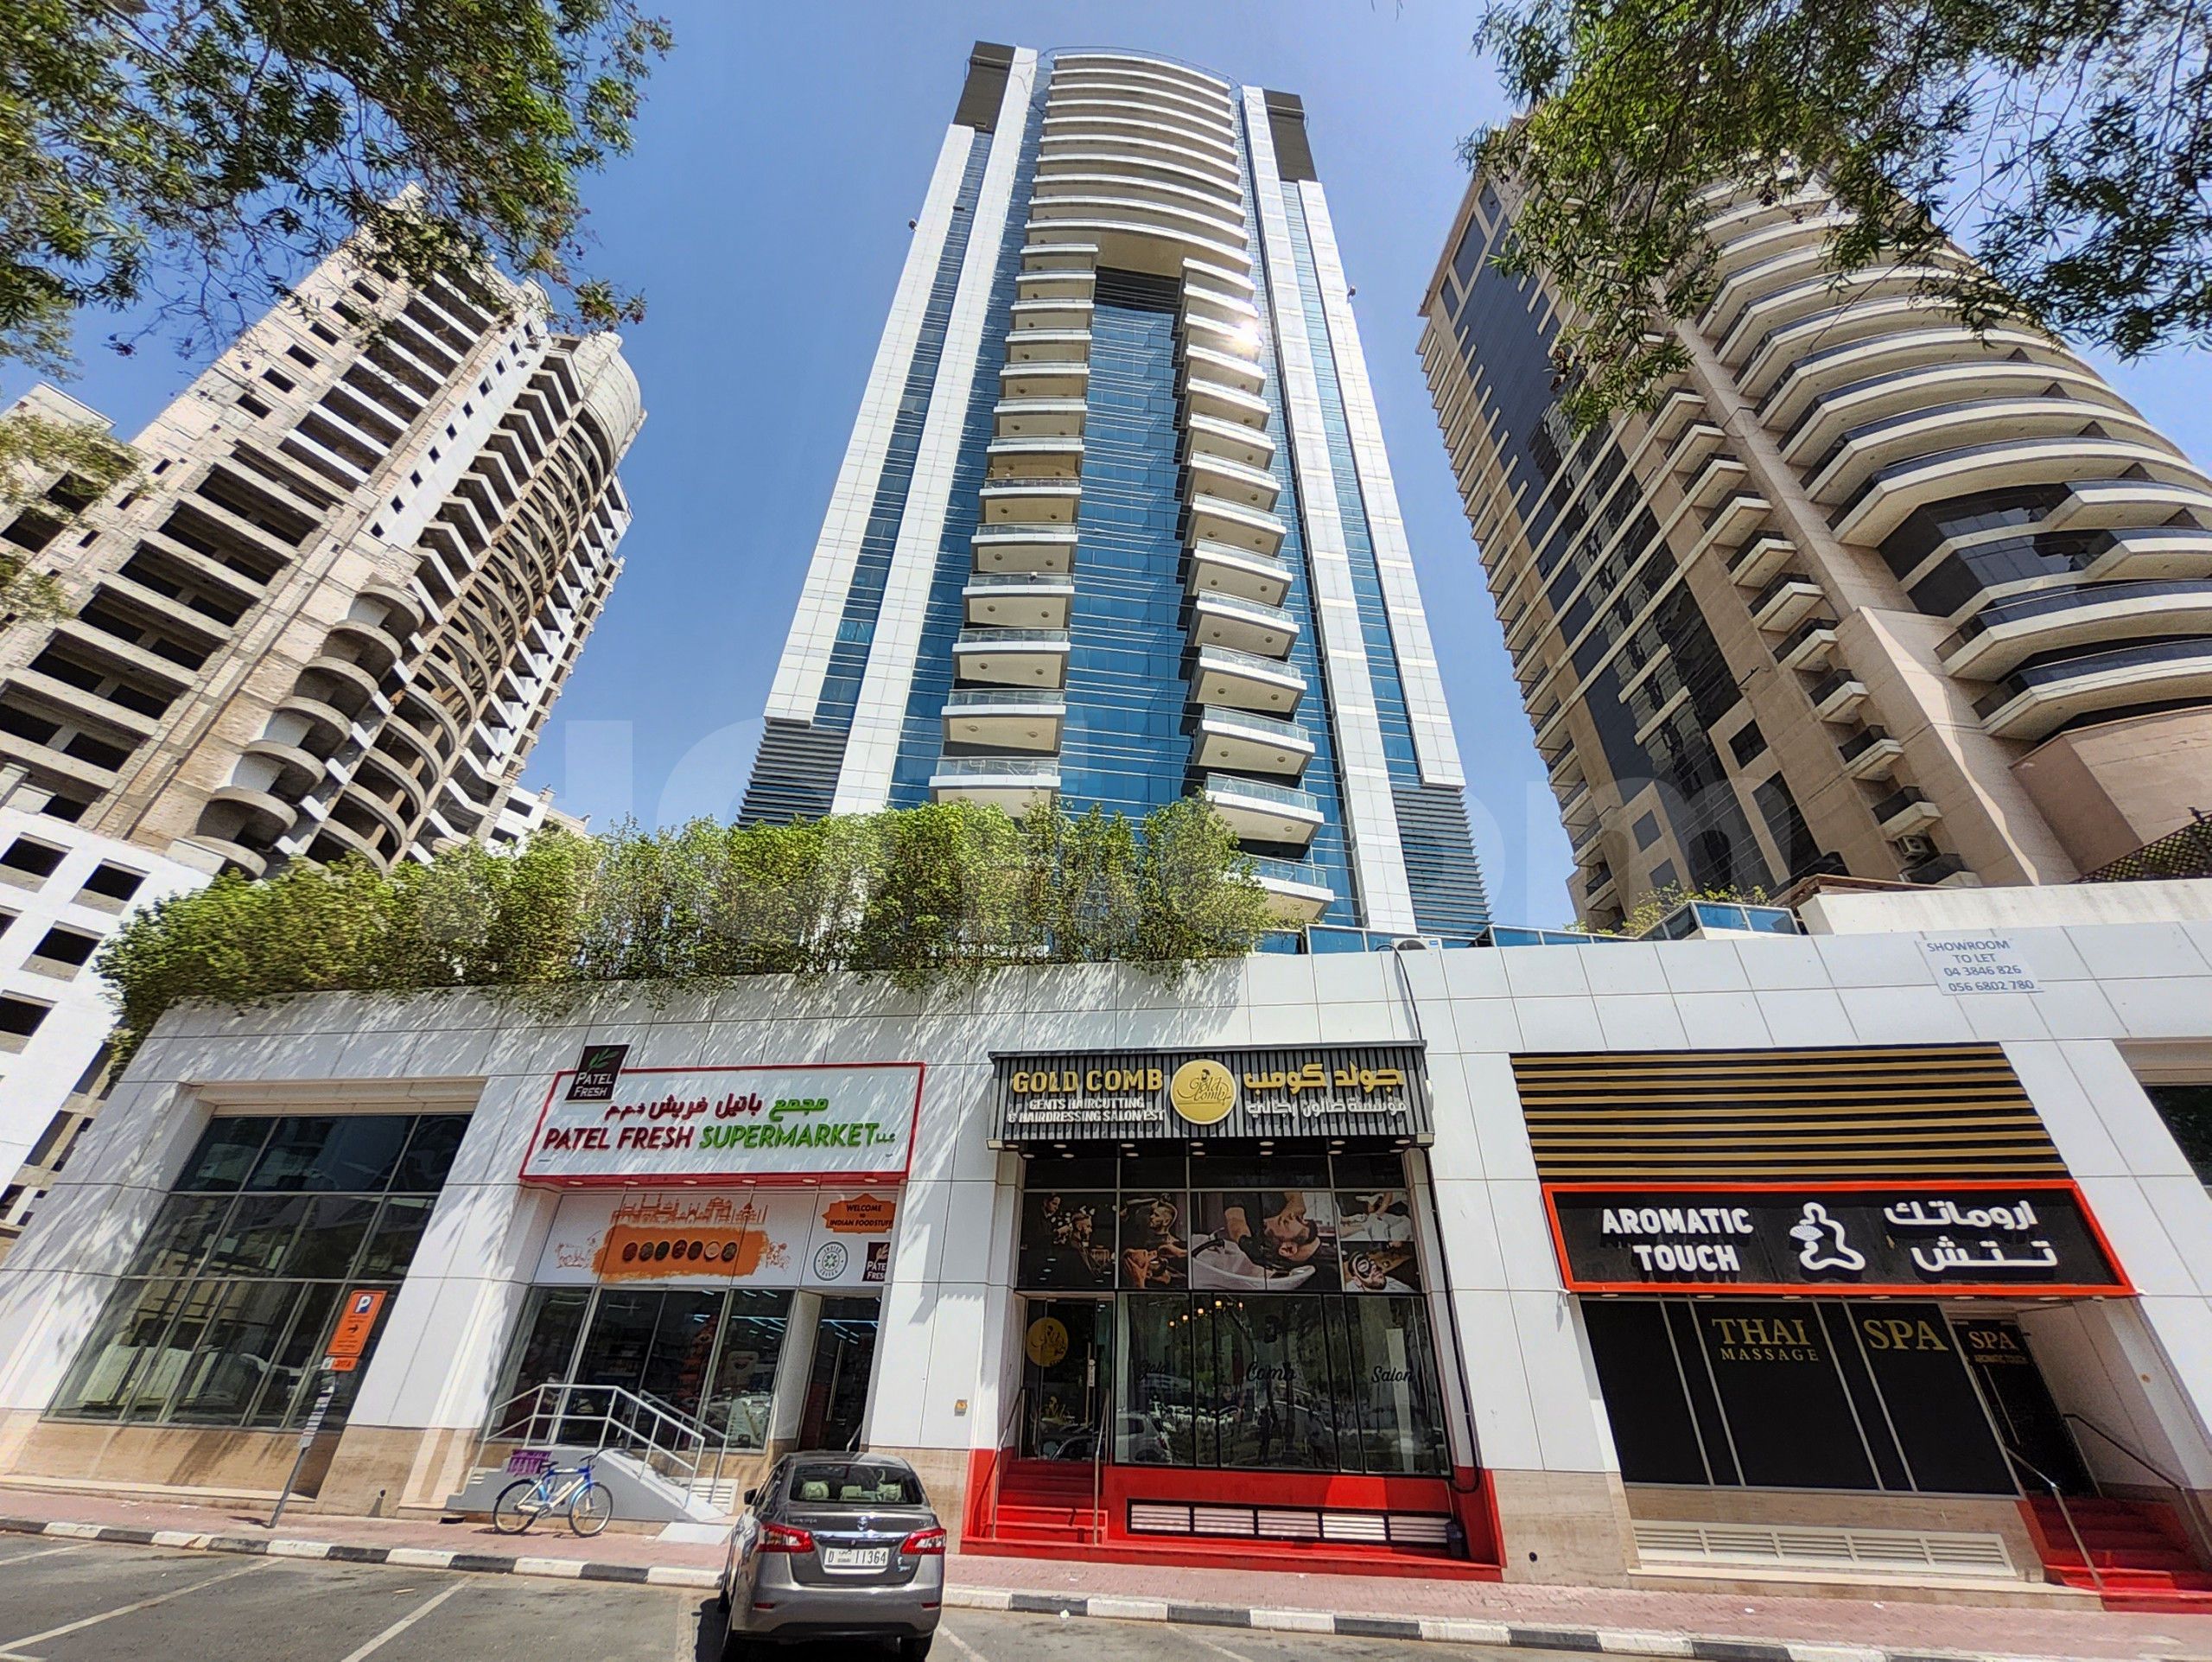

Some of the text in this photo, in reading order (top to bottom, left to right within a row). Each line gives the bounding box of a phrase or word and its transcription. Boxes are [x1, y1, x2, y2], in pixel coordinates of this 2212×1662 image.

[1927, 940, 2010, 952] SHOWROOM
[1952, 952, 1997, 964] TO LET
[1943, 965, 2022, 977] 04 3846 826
[1948, 979, 2035, 992] 056 6802 780
[575, 1072, 613, 1086] PATEL
[1013, 1068, 1163, 1093] GOLD COMB
[1243, 1060, 1405, 1095] جولد كومب
[573, 1086, 607, 1098] FRESH
[715, 1092, 763, 1120] باتيل
[768, 1097, 829, 1123] مجمع
[1029, 1097, 1145, 1111] GENTS HAIRCUTTING
[1007, 1111, 1018, 1123] &
[1019, 1111, 1102, 1123] HAIRDRESSING
[1103, 1110, 1141, 1122] SALON
[542, 1127, 611, 1150] PATEL
[616, 1125, 695, 1149] FRESH
[699, 1122, 880, 1149] SUPERMARKET
[1601, 1207, 1754, 1234] AROMATIC
[1632, 1244, 1741, 1271] TOUCH
[868, 1261, 886, 1270] PATE
[356, 1296, 371, 1312] P
[1711, 1318, 1950, 1352] THAI SPA
[1968, 1330, 2020, 1350] SPA
[1720, 1347, 1820, 1362] MASSAGE
[1370, 1365, 1413, 1383] Salon
[855, 1551, 887, 1564] 11364
